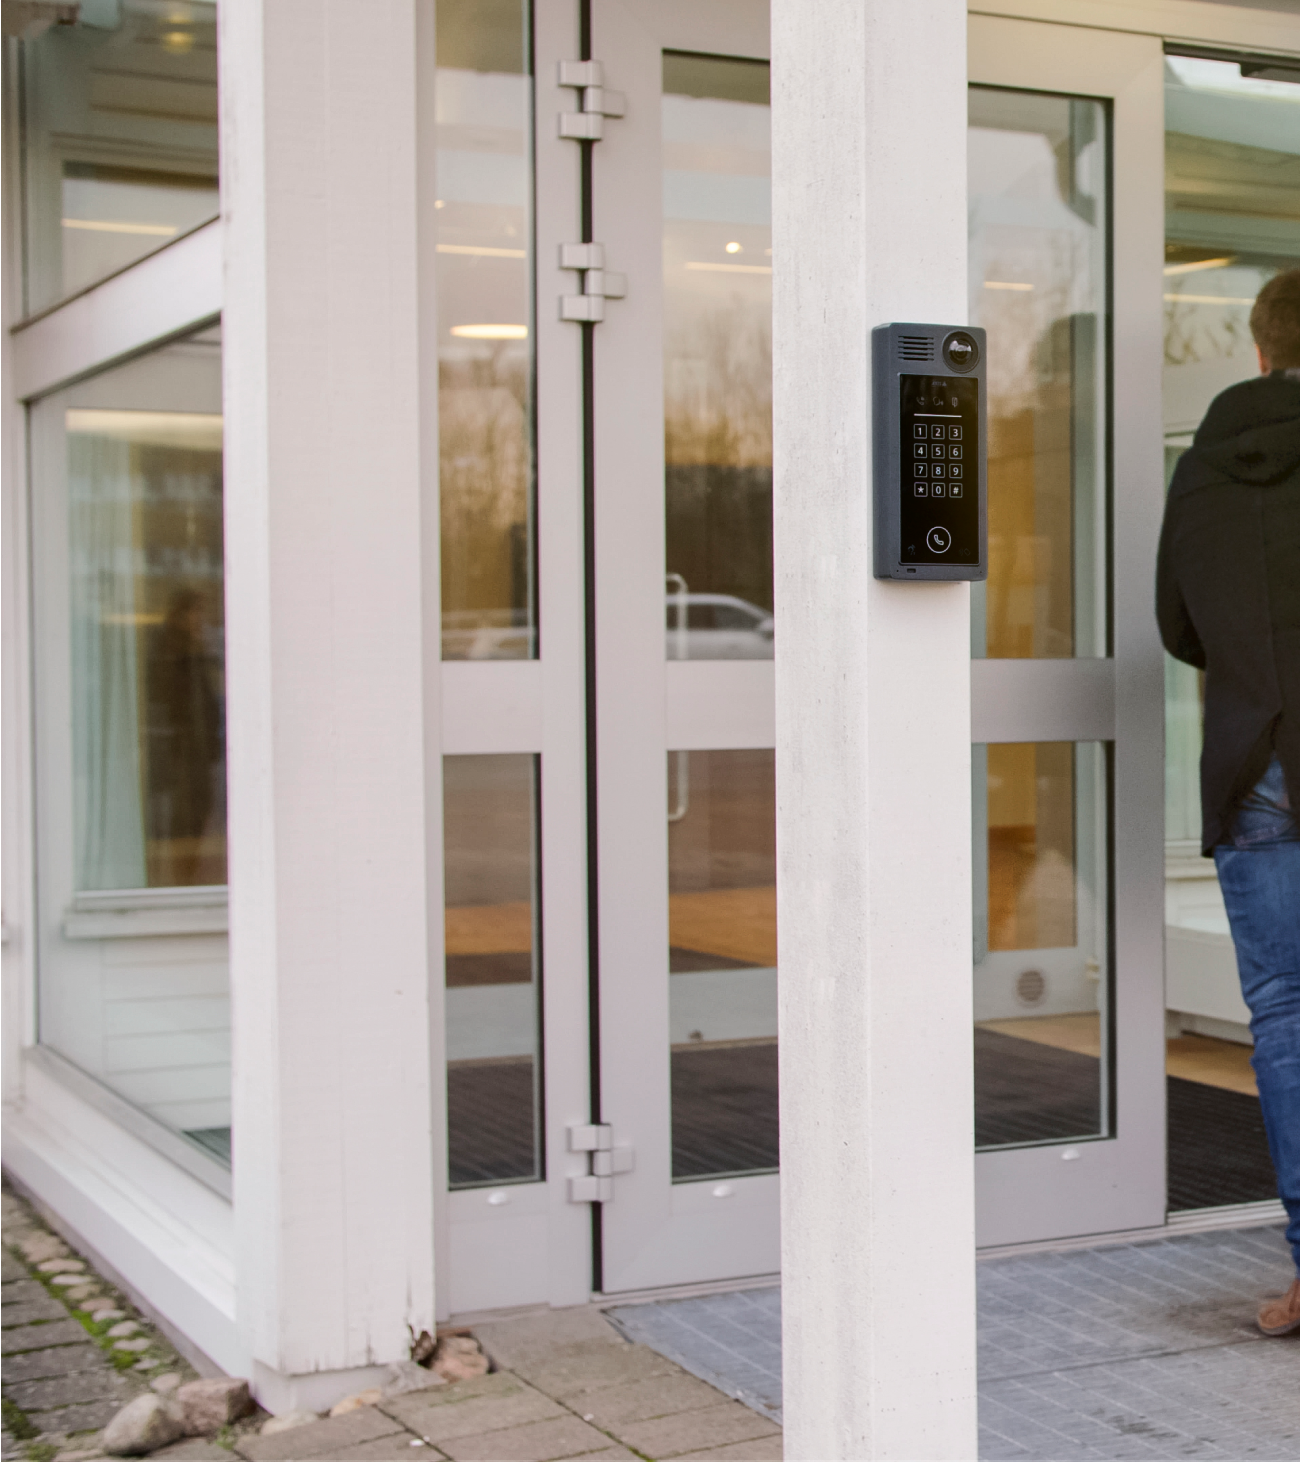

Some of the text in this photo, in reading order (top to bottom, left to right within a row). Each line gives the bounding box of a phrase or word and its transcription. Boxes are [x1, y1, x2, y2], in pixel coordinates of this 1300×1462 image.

[918, 427, 959, 437] 1 2 3
[917, 446, 959, 456] 4 5 6
[918, 465, 959, 476] 7 8 9
[935, 485, 941, 494] 0
[953, 486, 959, 494] #
